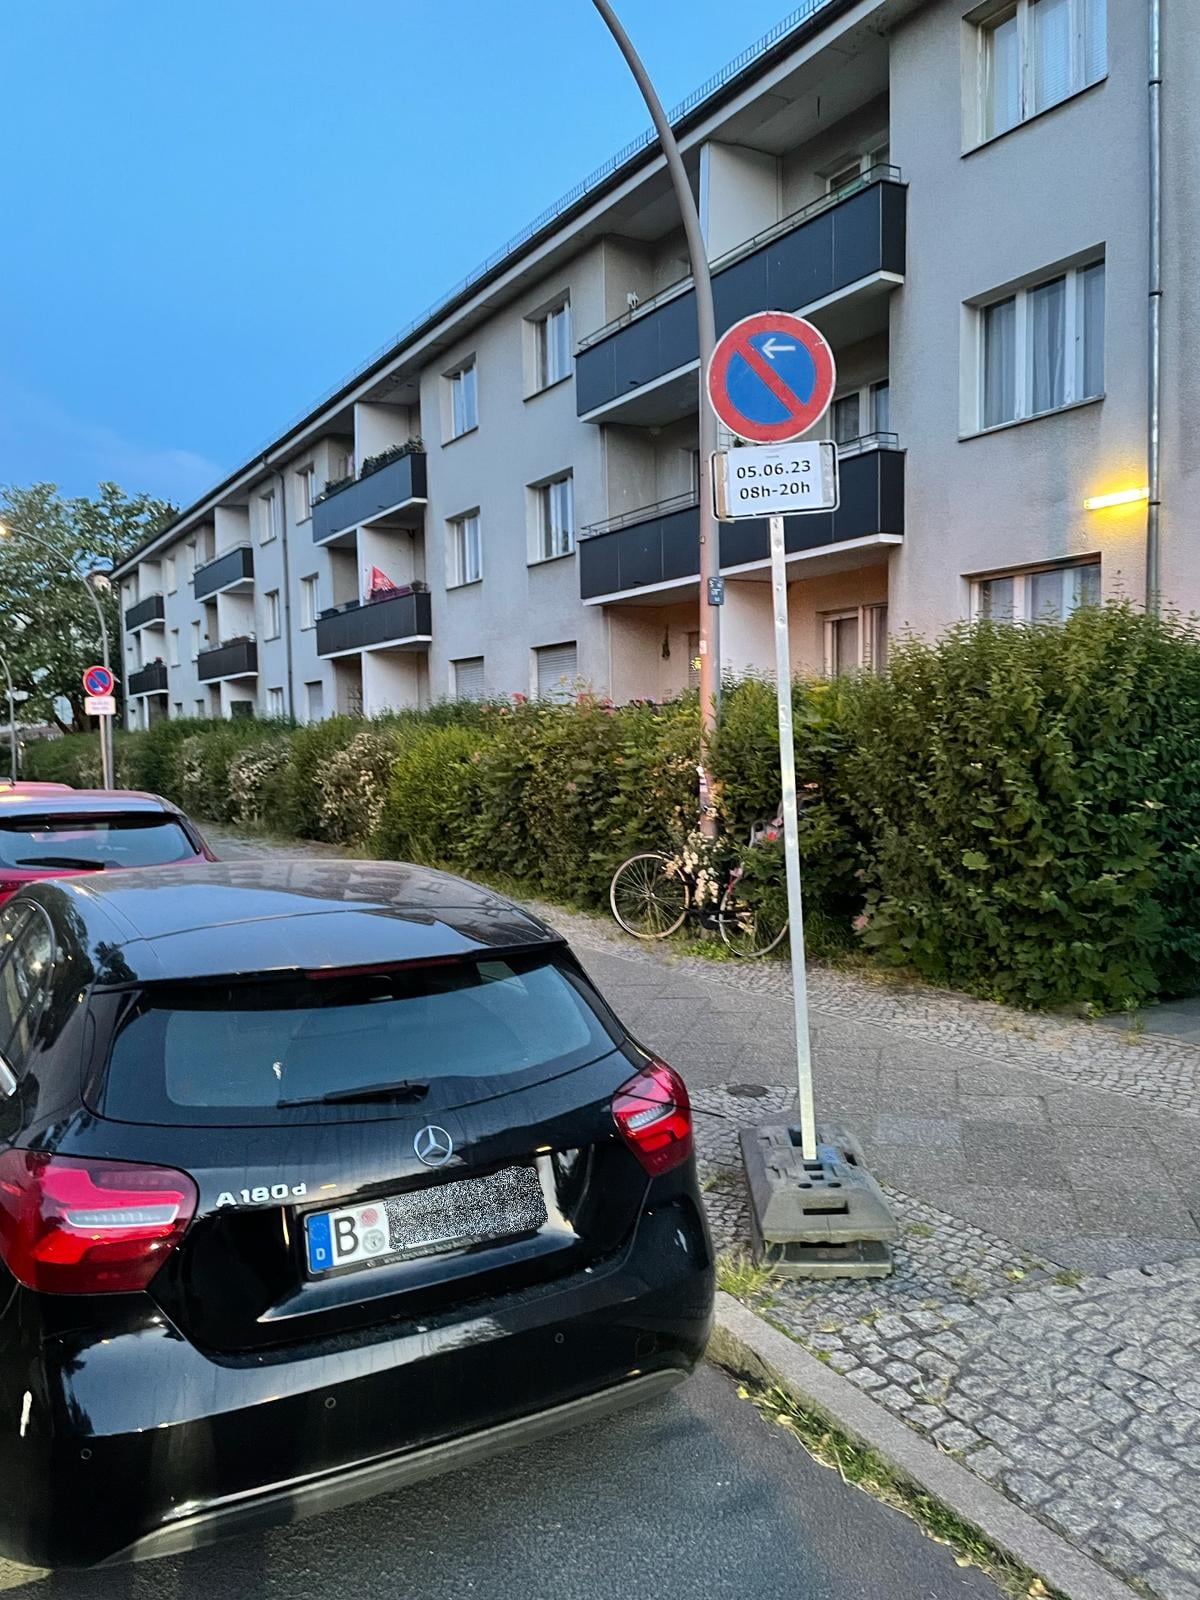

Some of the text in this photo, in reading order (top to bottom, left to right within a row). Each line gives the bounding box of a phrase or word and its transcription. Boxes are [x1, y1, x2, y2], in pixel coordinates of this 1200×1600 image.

[736, 460, 811, 479] 05.06.23
[739, 481, 811, 500] 08h-20h
[334, 1216, 359, 1258] B
[315, 1247, 326, 1261] D
